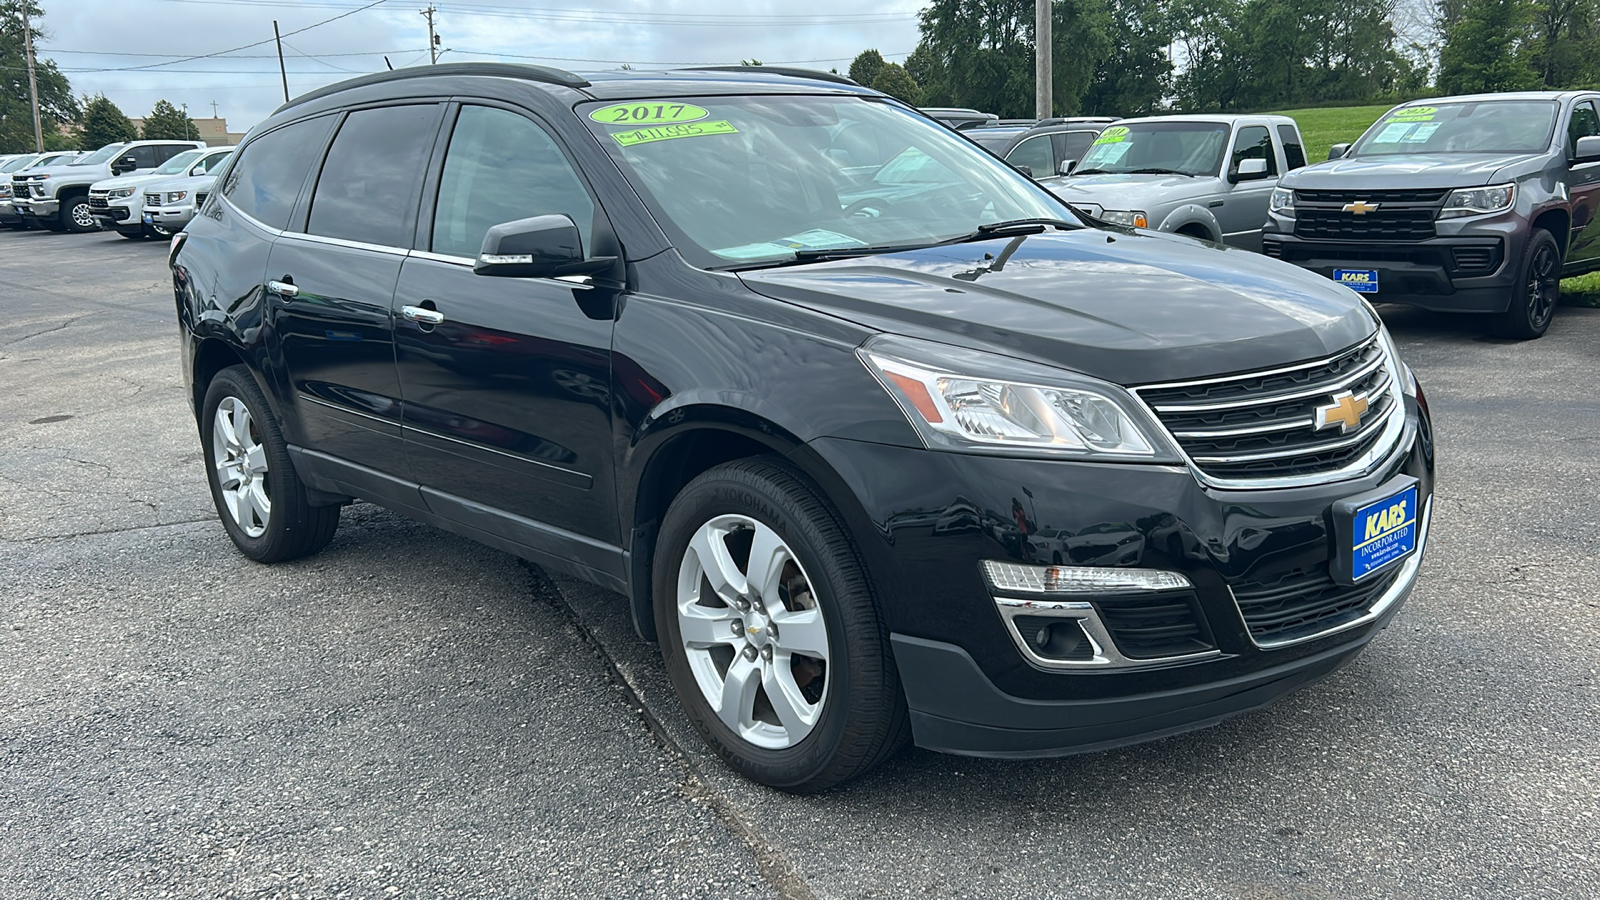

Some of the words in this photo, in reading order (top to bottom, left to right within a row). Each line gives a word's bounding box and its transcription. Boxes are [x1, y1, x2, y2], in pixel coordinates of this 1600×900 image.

[613, 105, 685, 122] 2017
[1341, 272, 1370, 282] KARS
[722, 487, 787, 535] YOKOHAMA
[1364, 500, 1407, 540] KARS
[1361, 527, 1408, 557] INCORPORATED
